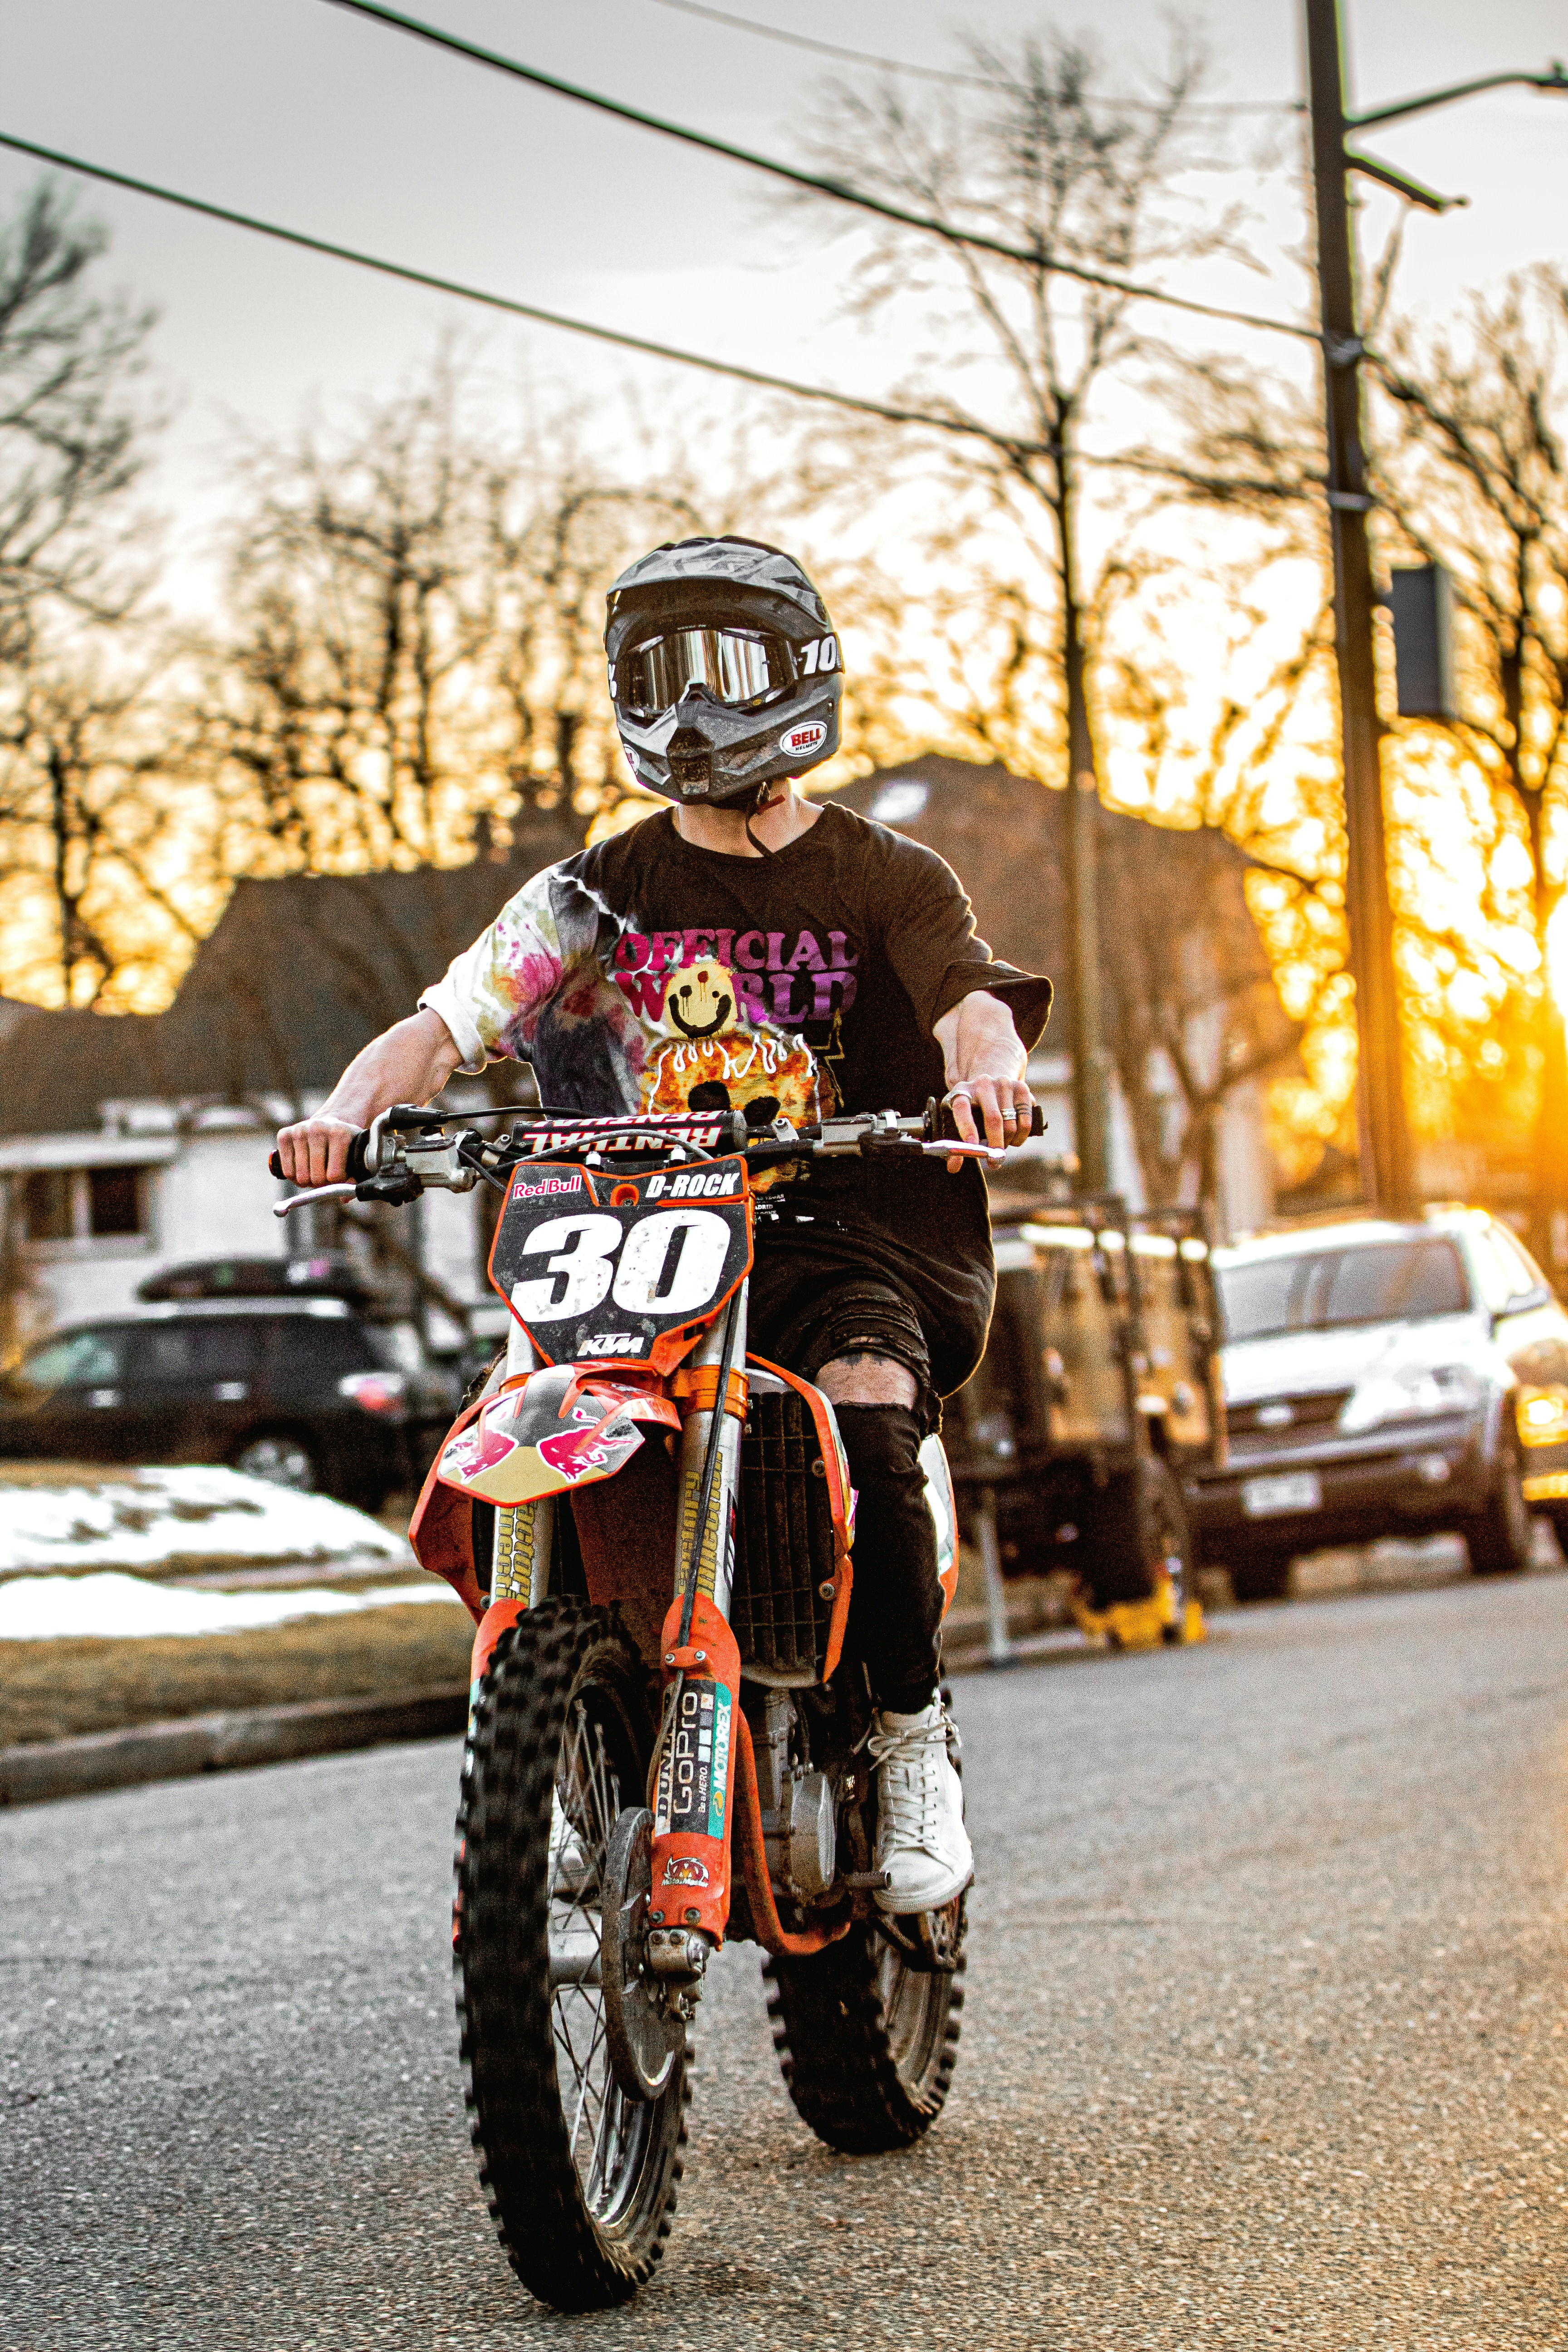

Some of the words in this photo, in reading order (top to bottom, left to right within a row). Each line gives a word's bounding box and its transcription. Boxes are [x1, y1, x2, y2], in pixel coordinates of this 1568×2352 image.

[800, 636, 842, 675] 10
[791, 728, 821, 747] BELL
[795, 740, 818, 751] HELMETS
[615, 929, 860, 972] OFFICIAL
[615, 971, 858, 1024] WRLD
[523, 1127, 722, 1154] RENTHAL
[512, 1179, 546, 1199] Red
[546, 1175, 582, 1195] Bull
[645, 1172, 740, 1198] D-ROCK
[510, 1210, 731, 1322] 30
[577, 1333, 644, 1356] KTM
[514, 1503, 535, 1607] actor
[673, 1692, 698, 1814] GoPro
[713, 1702, 730, 1791] MOTOREX
[698, 1765, 708, 1796] HERO.
[698, 1802, 706, 1813] Be
